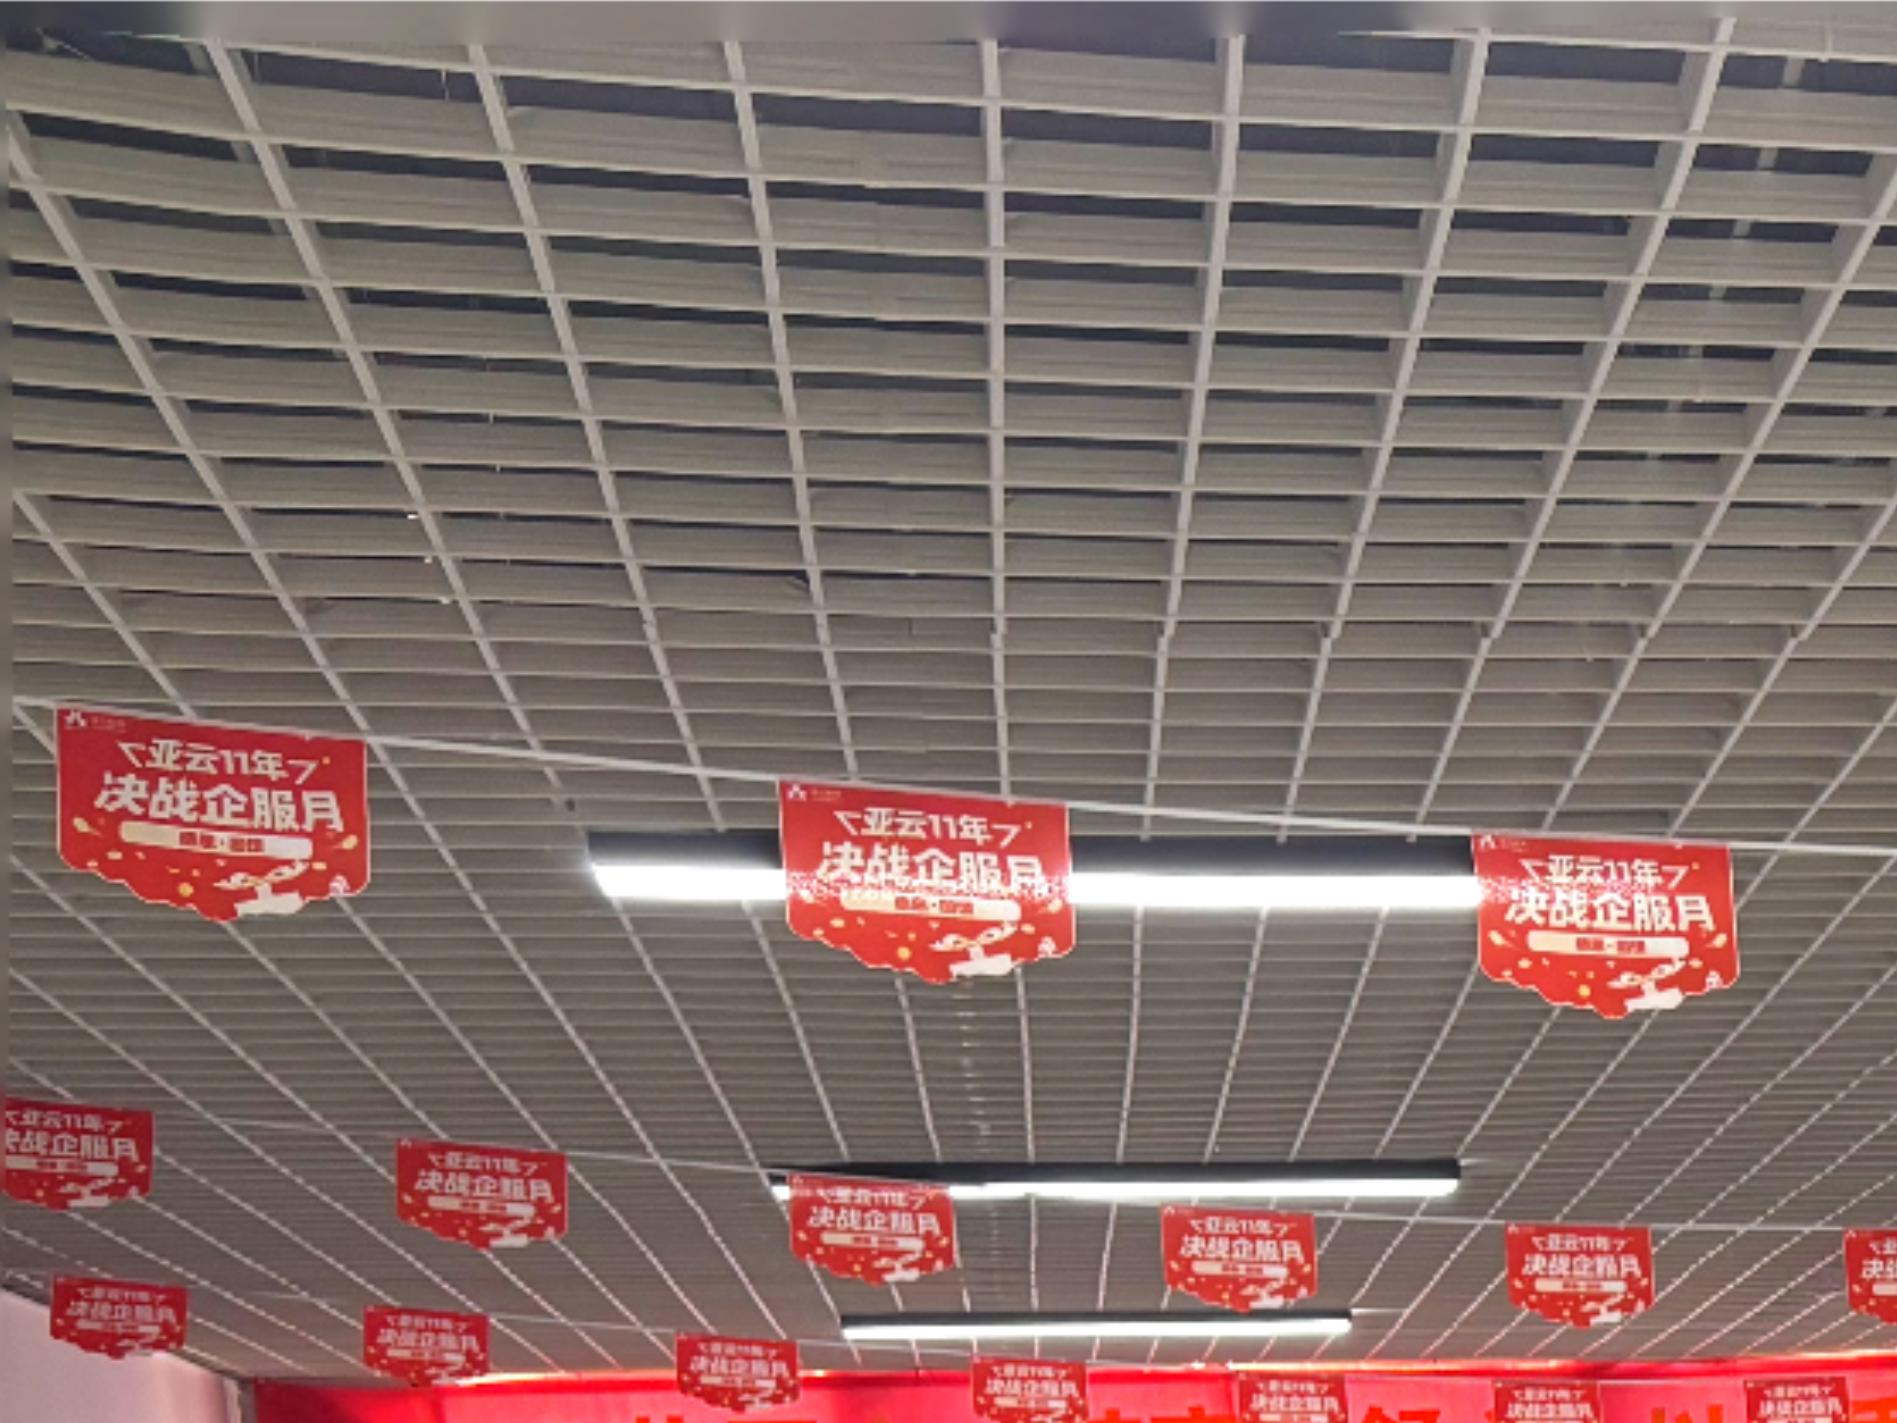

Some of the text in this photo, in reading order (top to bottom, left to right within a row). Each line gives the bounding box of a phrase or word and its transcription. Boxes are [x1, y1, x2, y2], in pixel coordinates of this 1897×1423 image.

[94, 771, 344, 832] 决战企服月
[816, 841, 1047, 898] 决战企服月
[1504, 887, 1715, 931] 决战企服月
[414, 1168, 554, 1202] 决战企服月
[809, 1206, 940, 1236] 决战企服月
[1179, 1236, 1305, 1264] 决战企服月
